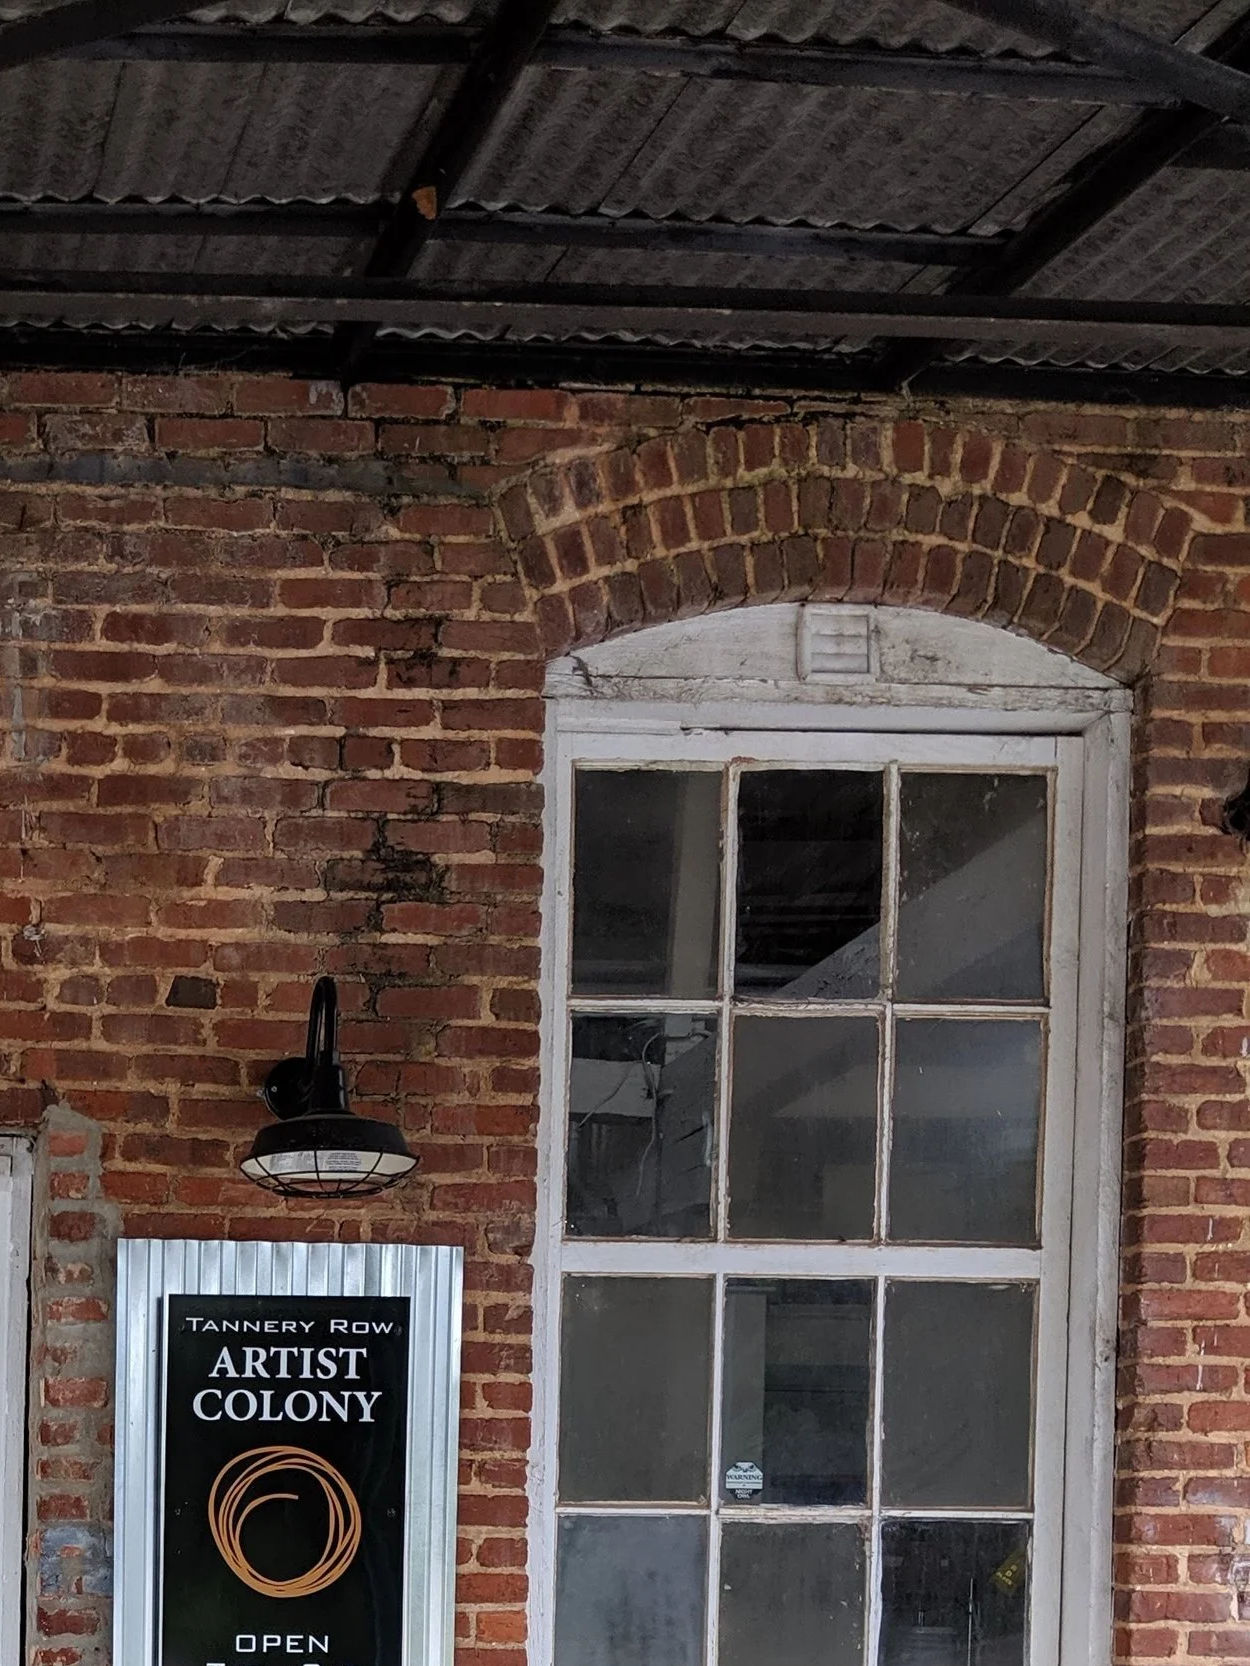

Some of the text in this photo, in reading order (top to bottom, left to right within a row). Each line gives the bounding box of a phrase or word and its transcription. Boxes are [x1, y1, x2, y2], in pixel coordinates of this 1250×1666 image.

[185, 1317, 394, 1334] TANNERY ROW
[208, 1346, 367, 1380] ARTIST
[192, 1388, 383, 1423] COLONY
[235, 1634, 329, 1654] OPEN
